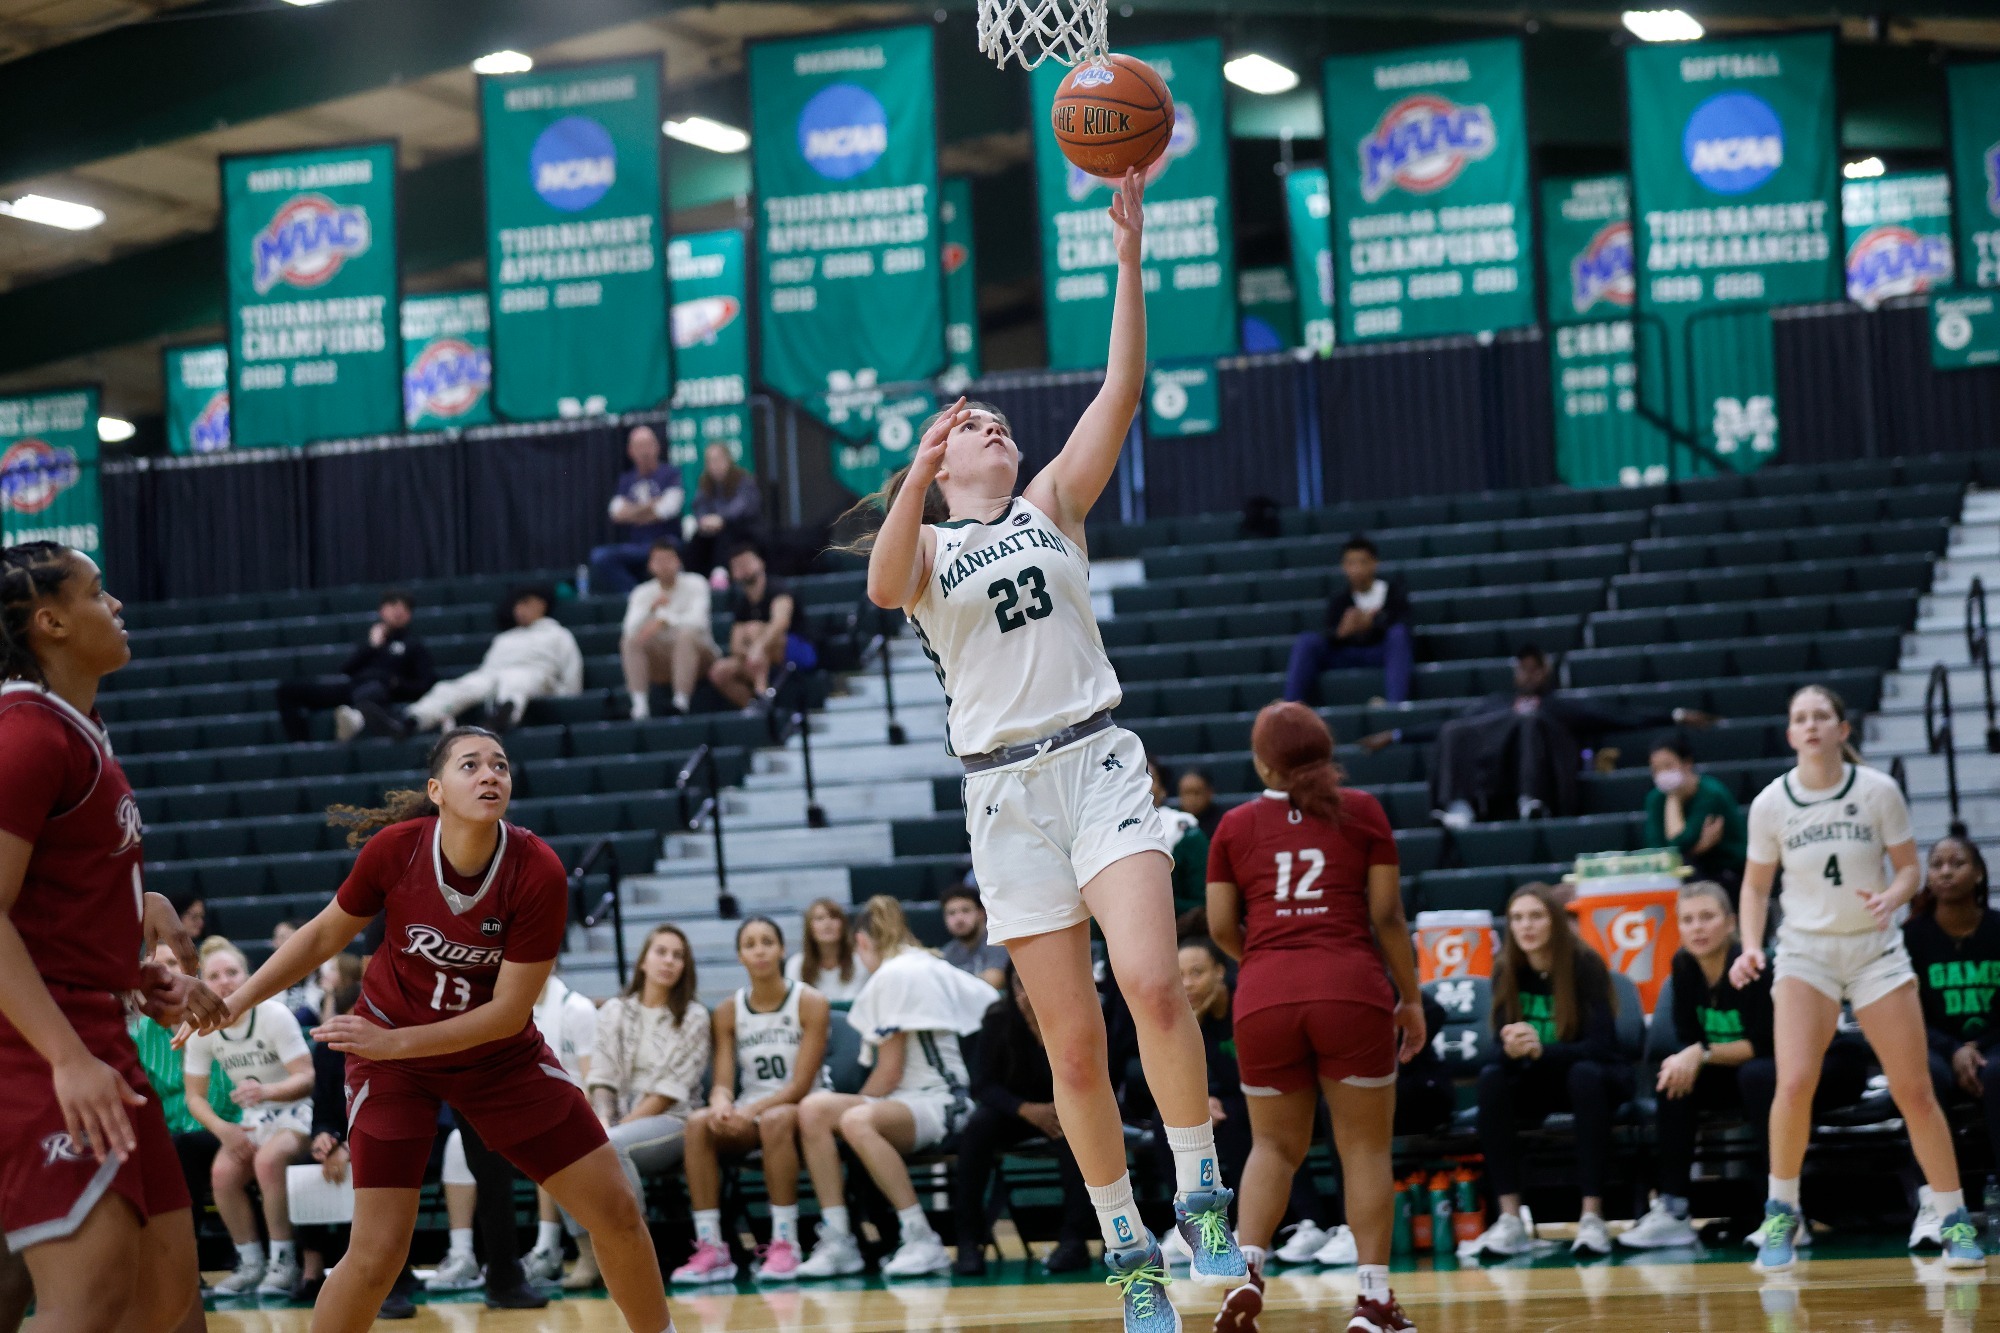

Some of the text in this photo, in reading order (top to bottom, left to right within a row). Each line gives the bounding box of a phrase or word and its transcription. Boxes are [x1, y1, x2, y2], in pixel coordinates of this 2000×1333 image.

[1053, 105, 1131, 135] THE ROCK
[806, 125, 888, 156] NCAA
[1358, 103, 1497, 203] MAAC
[1691, 135, 1784, 172] NCAA
[536, 156, 616, 192] NCAA
[764, 184, 928, 225] TOURNAMENT
[1053, 196, 1218, 235] TOURMENT
[1645, 201, 1827, 240] TOURNAMENT
[252, 205, 372, 296] MAAC
[499, 214, 653, 253] TOURNAMENT
[1057, 223, 1219, 271] CHAPIONS
[1350, 227, 1519, 275] CHAMPIONS
[1647, 230, 1829, 271] APPEARANCES
[240, 296, 386, 331] TOURNAMENT
[242, 322, 385, 362] CHAMPIONS
[1713, 395, 1778, 455] M
[939, 528, 1069, 600] MANHATTAN
[987, 565, 1054, 634] 23
[1274, 848, 1326, 901] 12
[1823, 853, 1843, 887] 4
[482, 922, 501, 932] BLM
[1611, 911, 1648, 950] G
[1436, 935, 1466, 966] G
[430, 970, 471, 1011] 13
[1928, 960, 2000, 990] GAME
[1944, 987, 1997, 1016] DAY
[755, 1054, 787, 1080] 20
